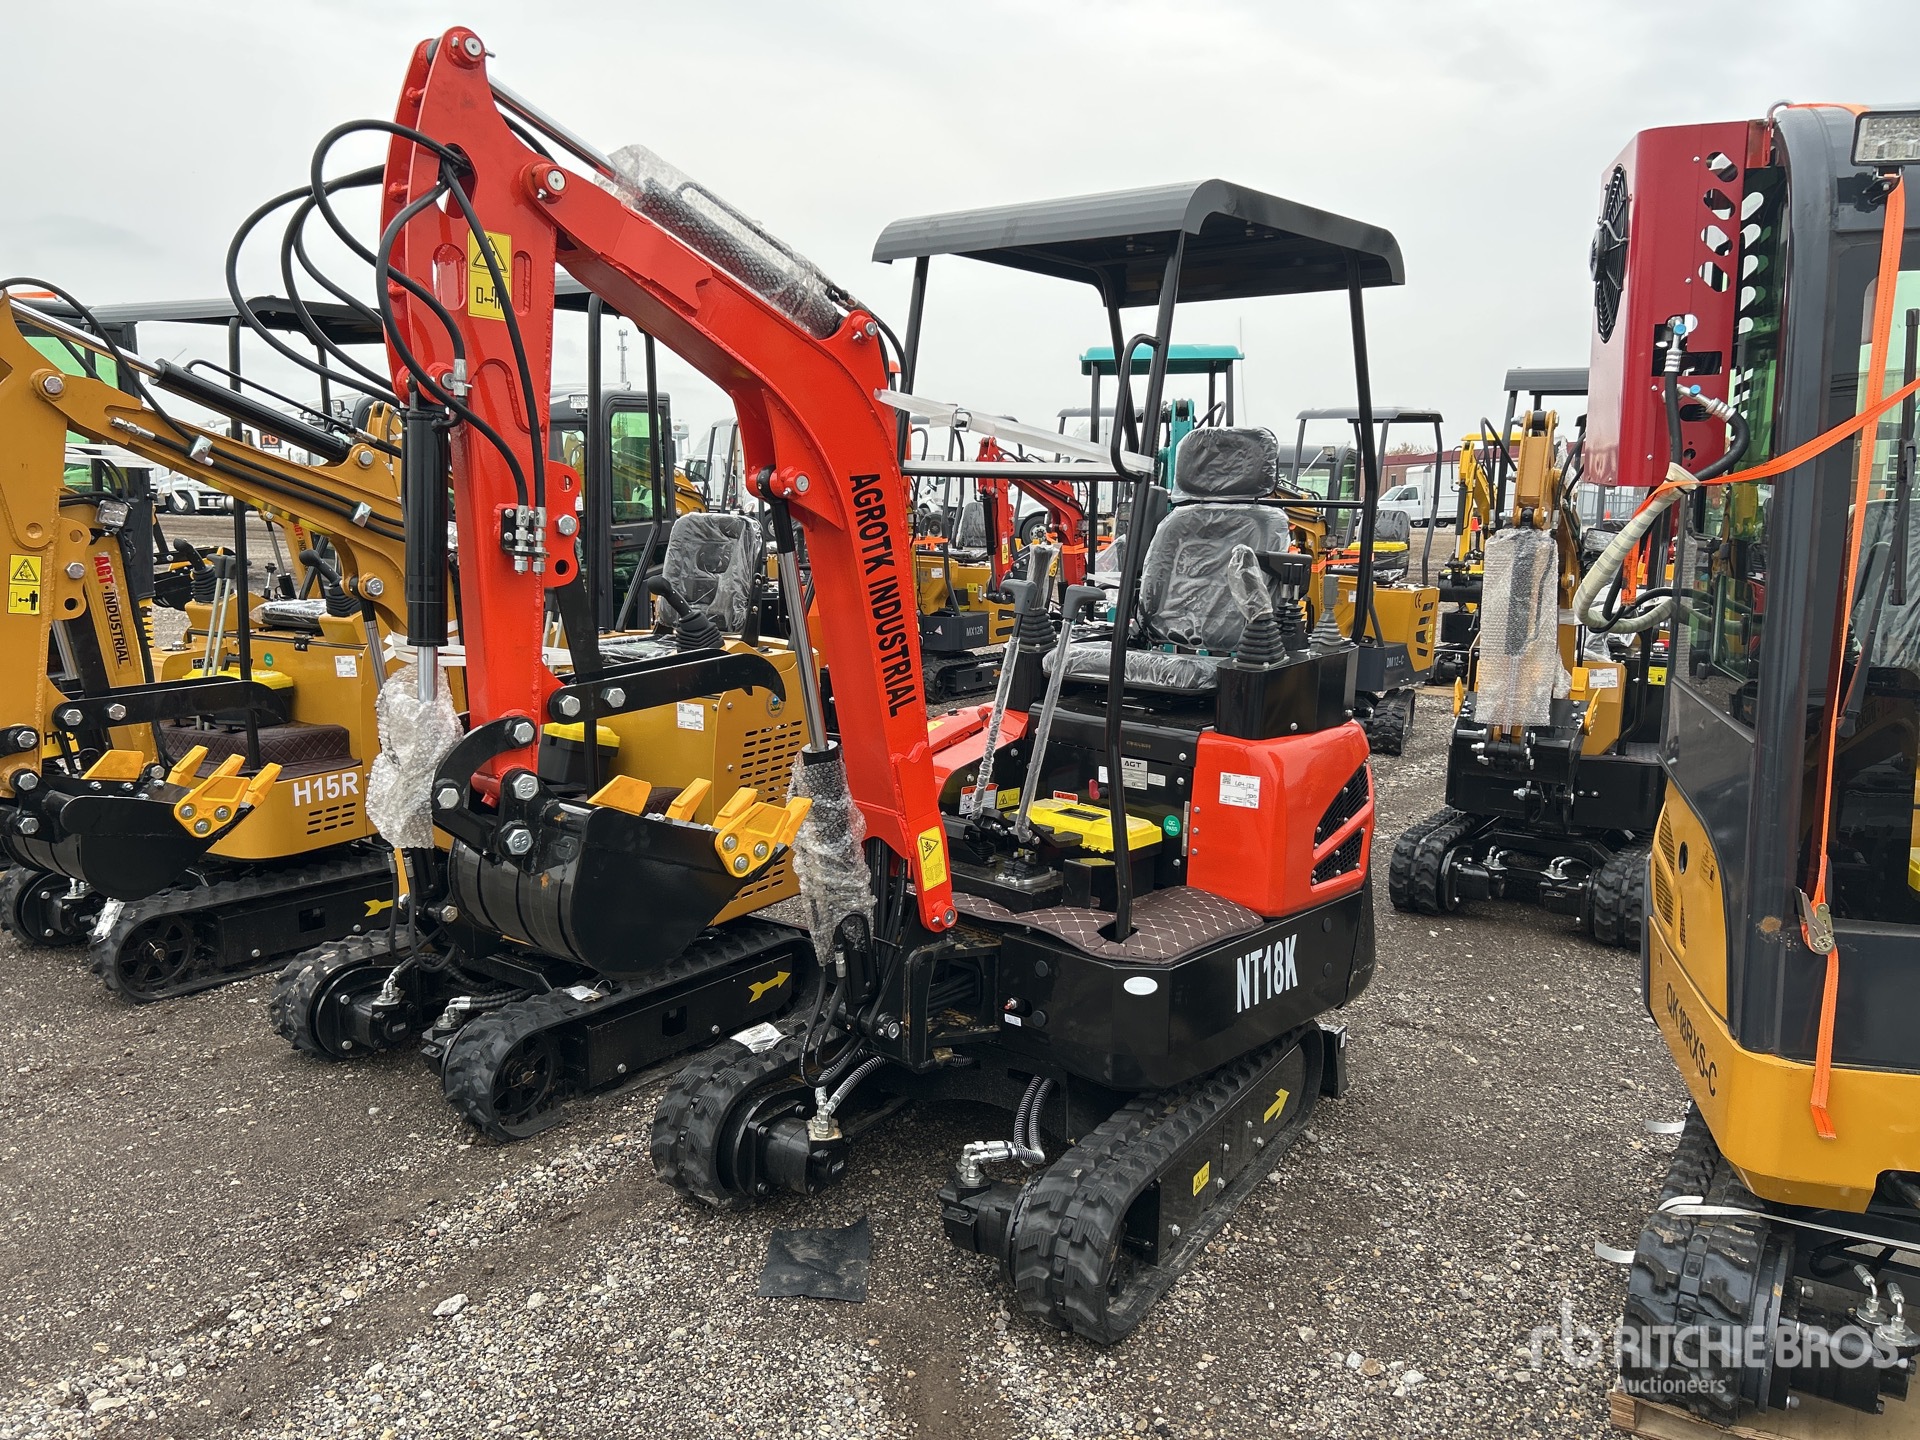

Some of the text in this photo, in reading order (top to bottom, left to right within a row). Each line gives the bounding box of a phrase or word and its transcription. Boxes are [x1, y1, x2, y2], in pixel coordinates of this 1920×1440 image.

[94, 556, 129, 665] AGT INDUSTRIAL
[850, 473, 917, 718] AGROTK INDUSTRIAL
[293, 772, 359, 807] H15R
[1124, 760, 1142, 768] AGT
[1236, 933, 1299, 1014] NT18K
